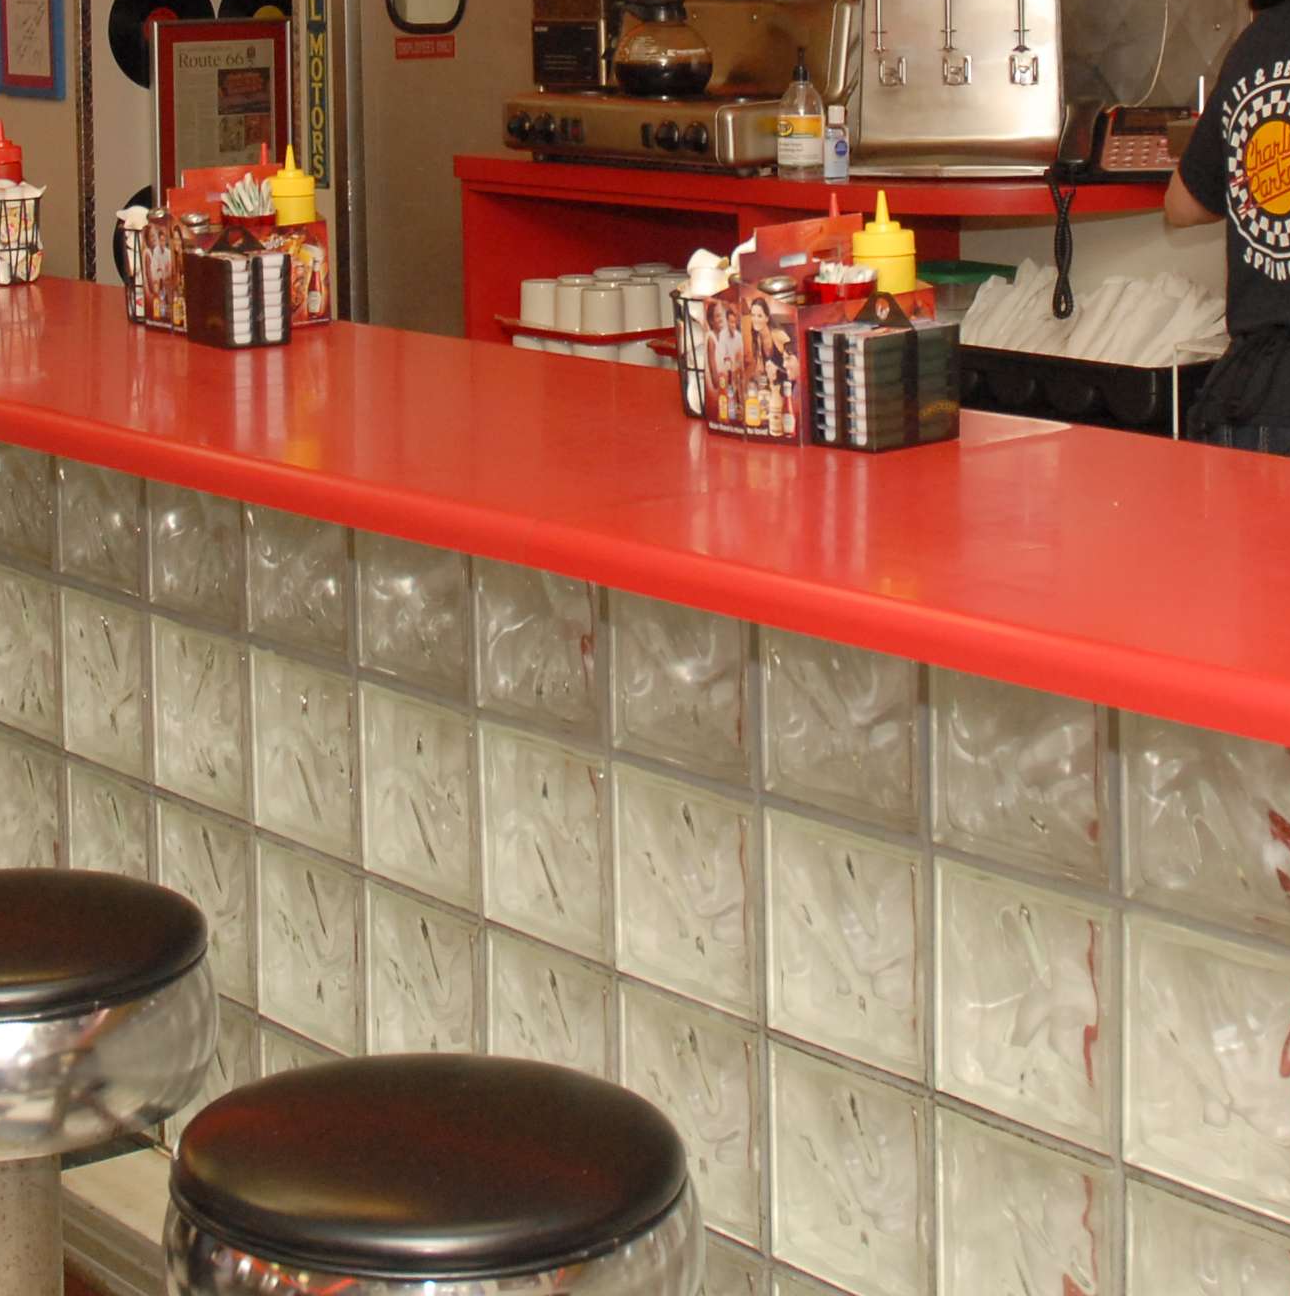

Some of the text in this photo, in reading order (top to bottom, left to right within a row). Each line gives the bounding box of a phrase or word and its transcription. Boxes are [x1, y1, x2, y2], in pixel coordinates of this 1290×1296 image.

[177, 53, 245, 70] Route 66
[1231, 76, 1249, 102] IT
[1254, 68, 1266, 86] &
[310, 34, 326, 179] MOTORS
